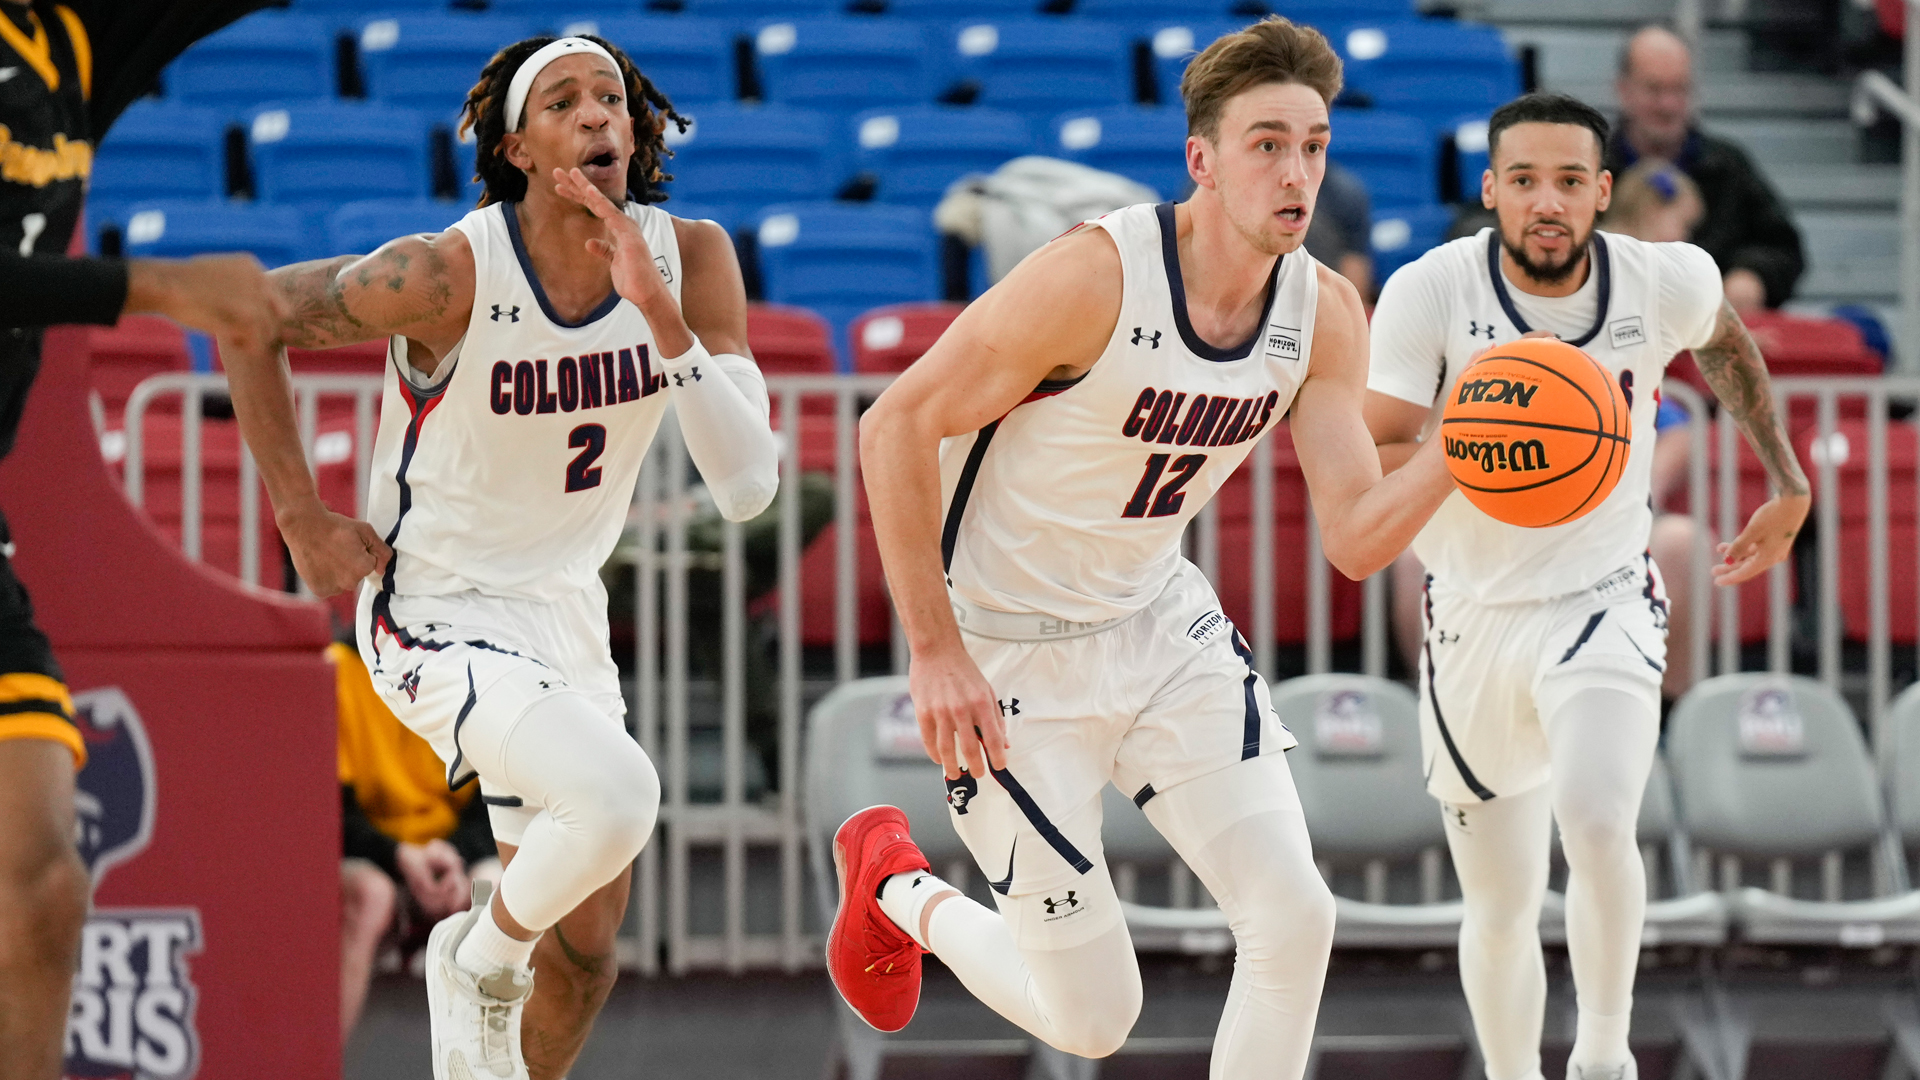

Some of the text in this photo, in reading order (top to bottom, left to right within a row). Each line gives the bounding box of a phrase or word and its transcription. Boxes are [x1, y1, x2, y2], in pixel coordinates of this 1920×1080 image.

[1269, 337, 1296, 347] HORIZON
[1457, 378, 1540, 408] NCAA
[1121, 386, 1279, 447] COLONIALS
[564, 422, 607, 494] 2
[1444, 434, 1550, 474] Wilson
[1120, 452, 1208, 518] 12
[1190, 612, 1223, 641] HORIZON
